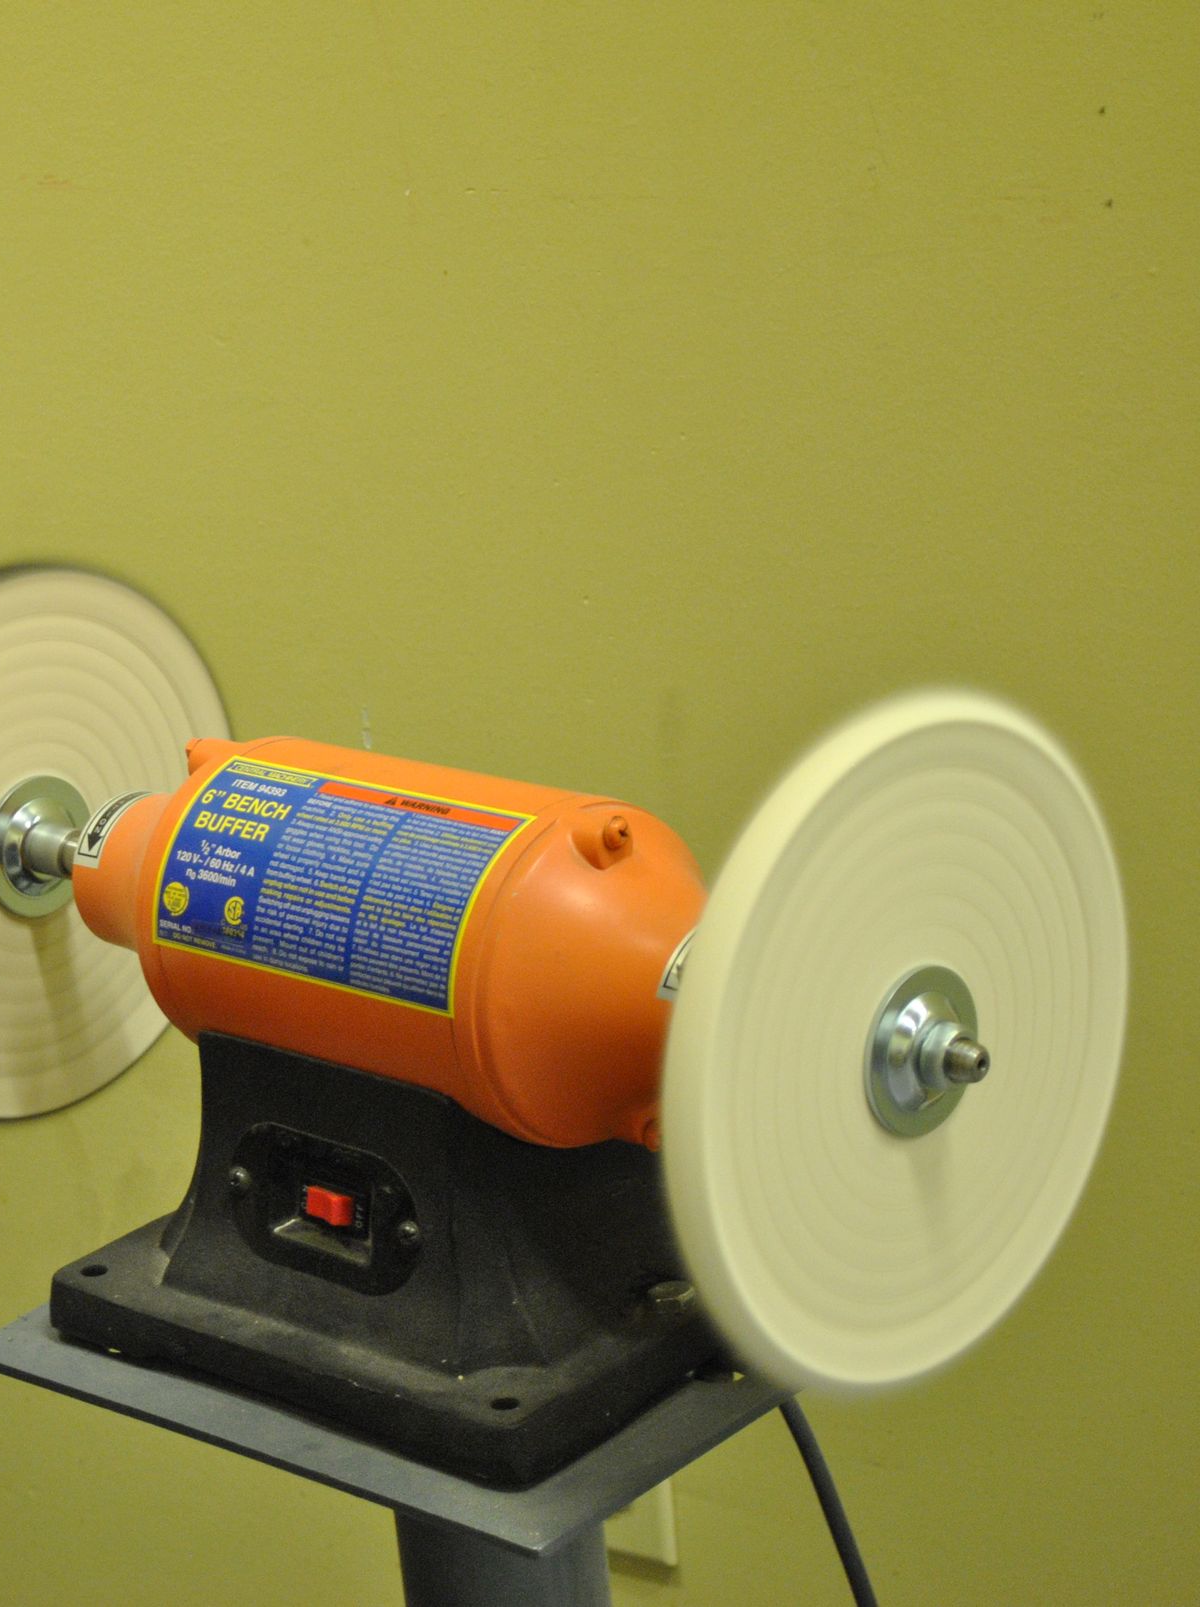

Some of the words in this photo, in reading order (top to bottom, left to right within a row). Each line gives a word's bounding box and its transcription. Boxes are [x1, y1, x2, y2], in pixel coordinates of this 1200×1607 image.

[232, 779, 257, 792] ITEM
[257, 784, 288, 797] 94393
[223, 793, 292, 820] BENCH
[400, 800, 451, 815] WARNING
[194, 811, 270, 842] BUFFER
[215, 845, 241, 859] Arbor
[176, 850, 192, 862] 120
[209, 858, 222, 869] 60
[221, 860, 235, 873] Hz
[240, 865, 247, 875] 4
[246, 866, 255, 877] A
[197, 869, 237, 887] 3600/min
